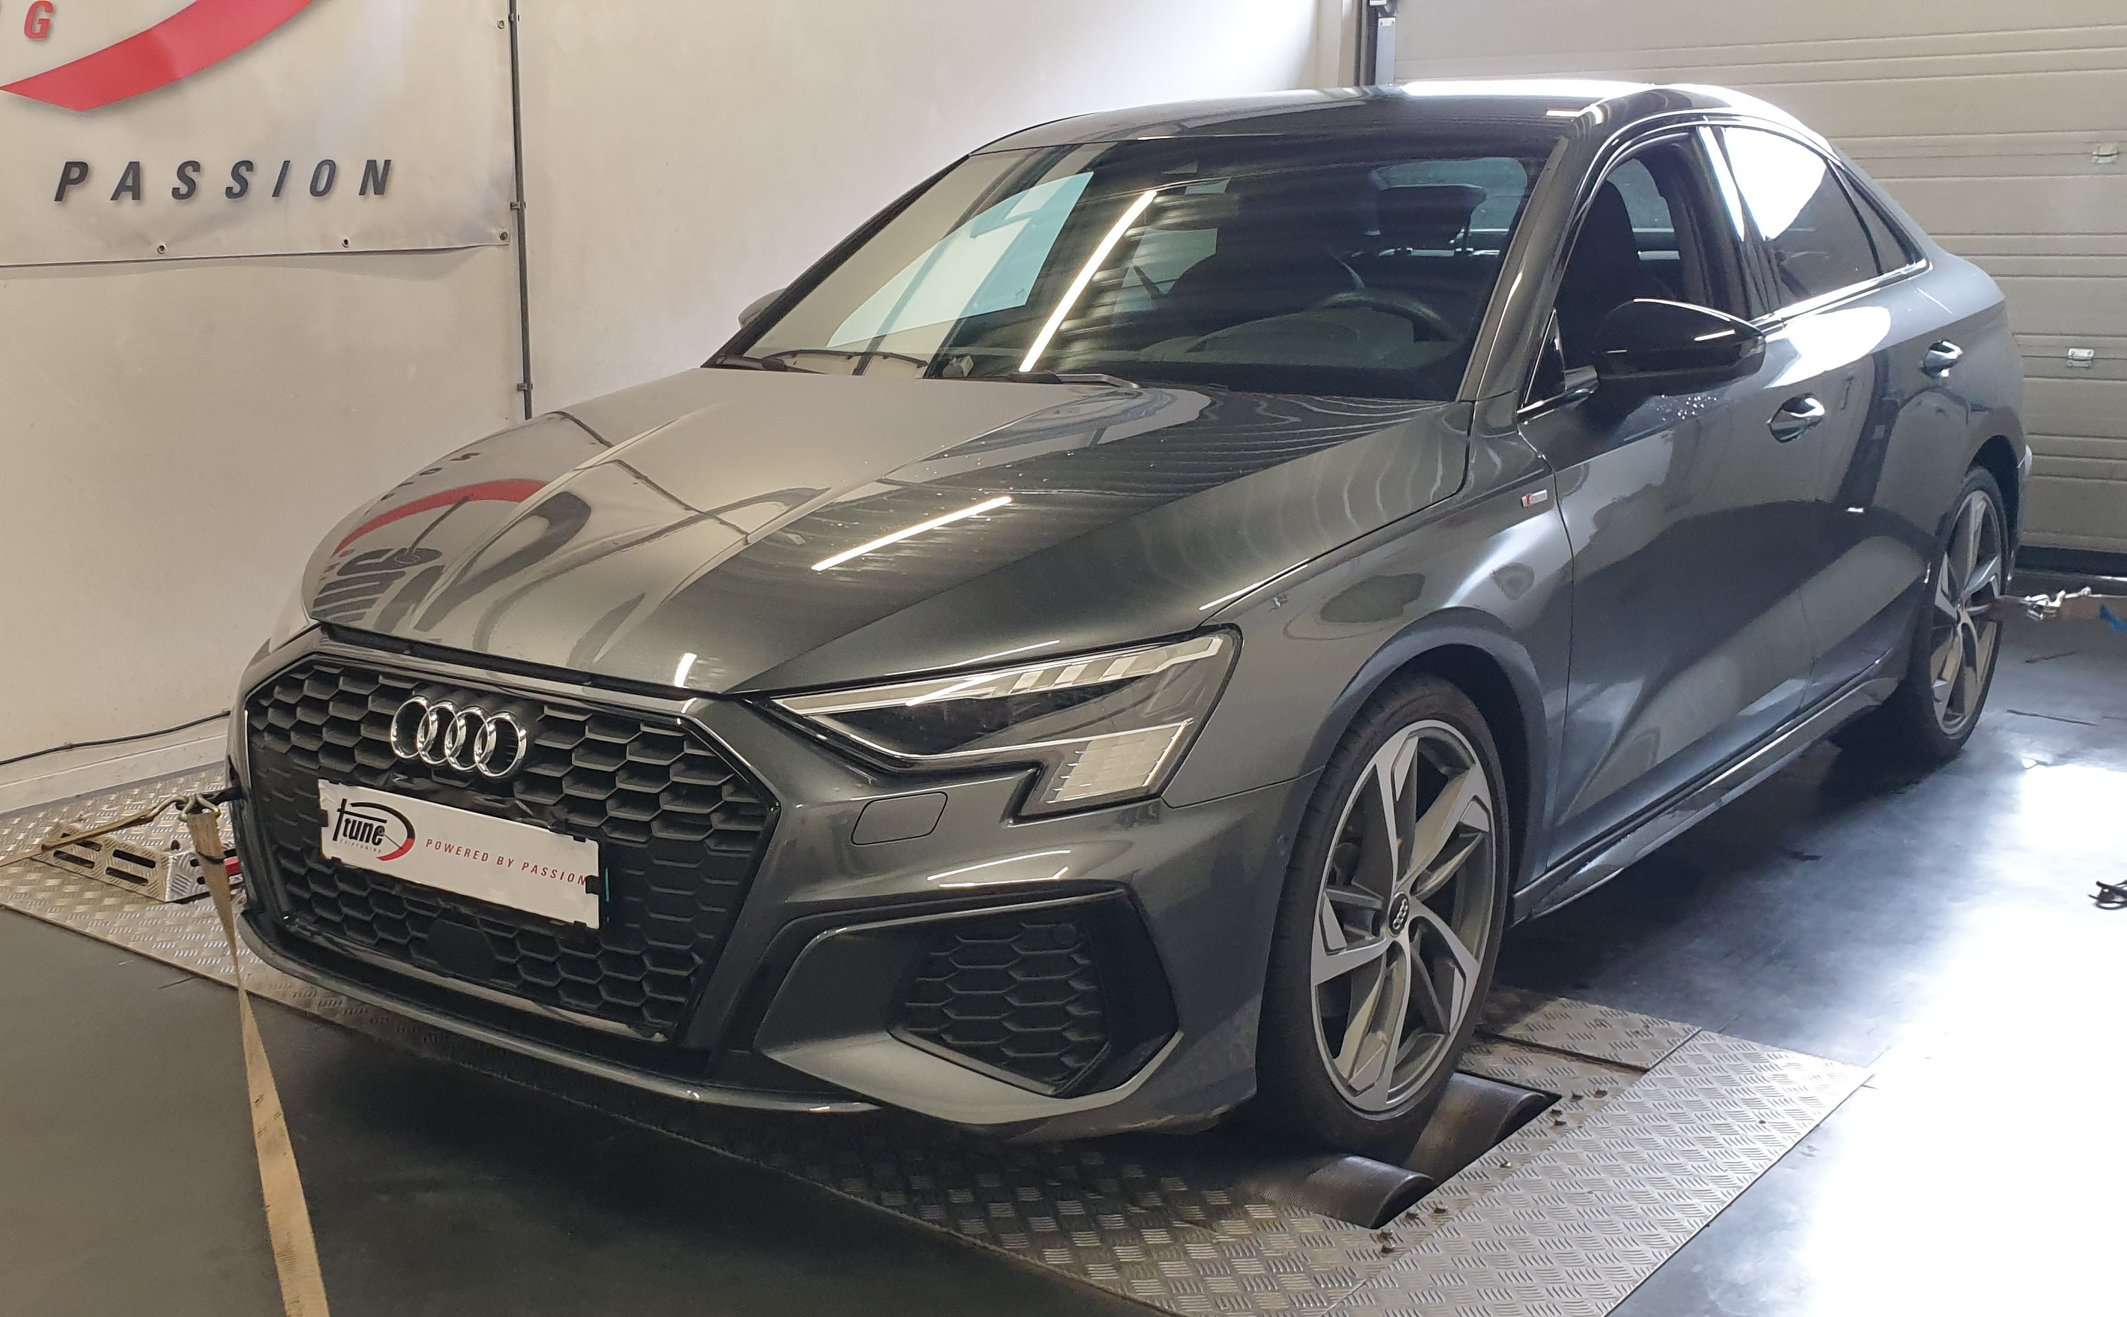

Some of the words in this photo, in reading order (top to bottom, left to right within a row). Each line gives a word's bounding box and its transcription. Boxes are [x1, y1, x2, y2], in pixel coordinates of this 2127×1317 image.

[54, 159, 392, 201] PASSION
[425, 838, 489, 862] POWERED
[496, 855, 515, 868] BY
[521, 862, 588, 886] PASSION
